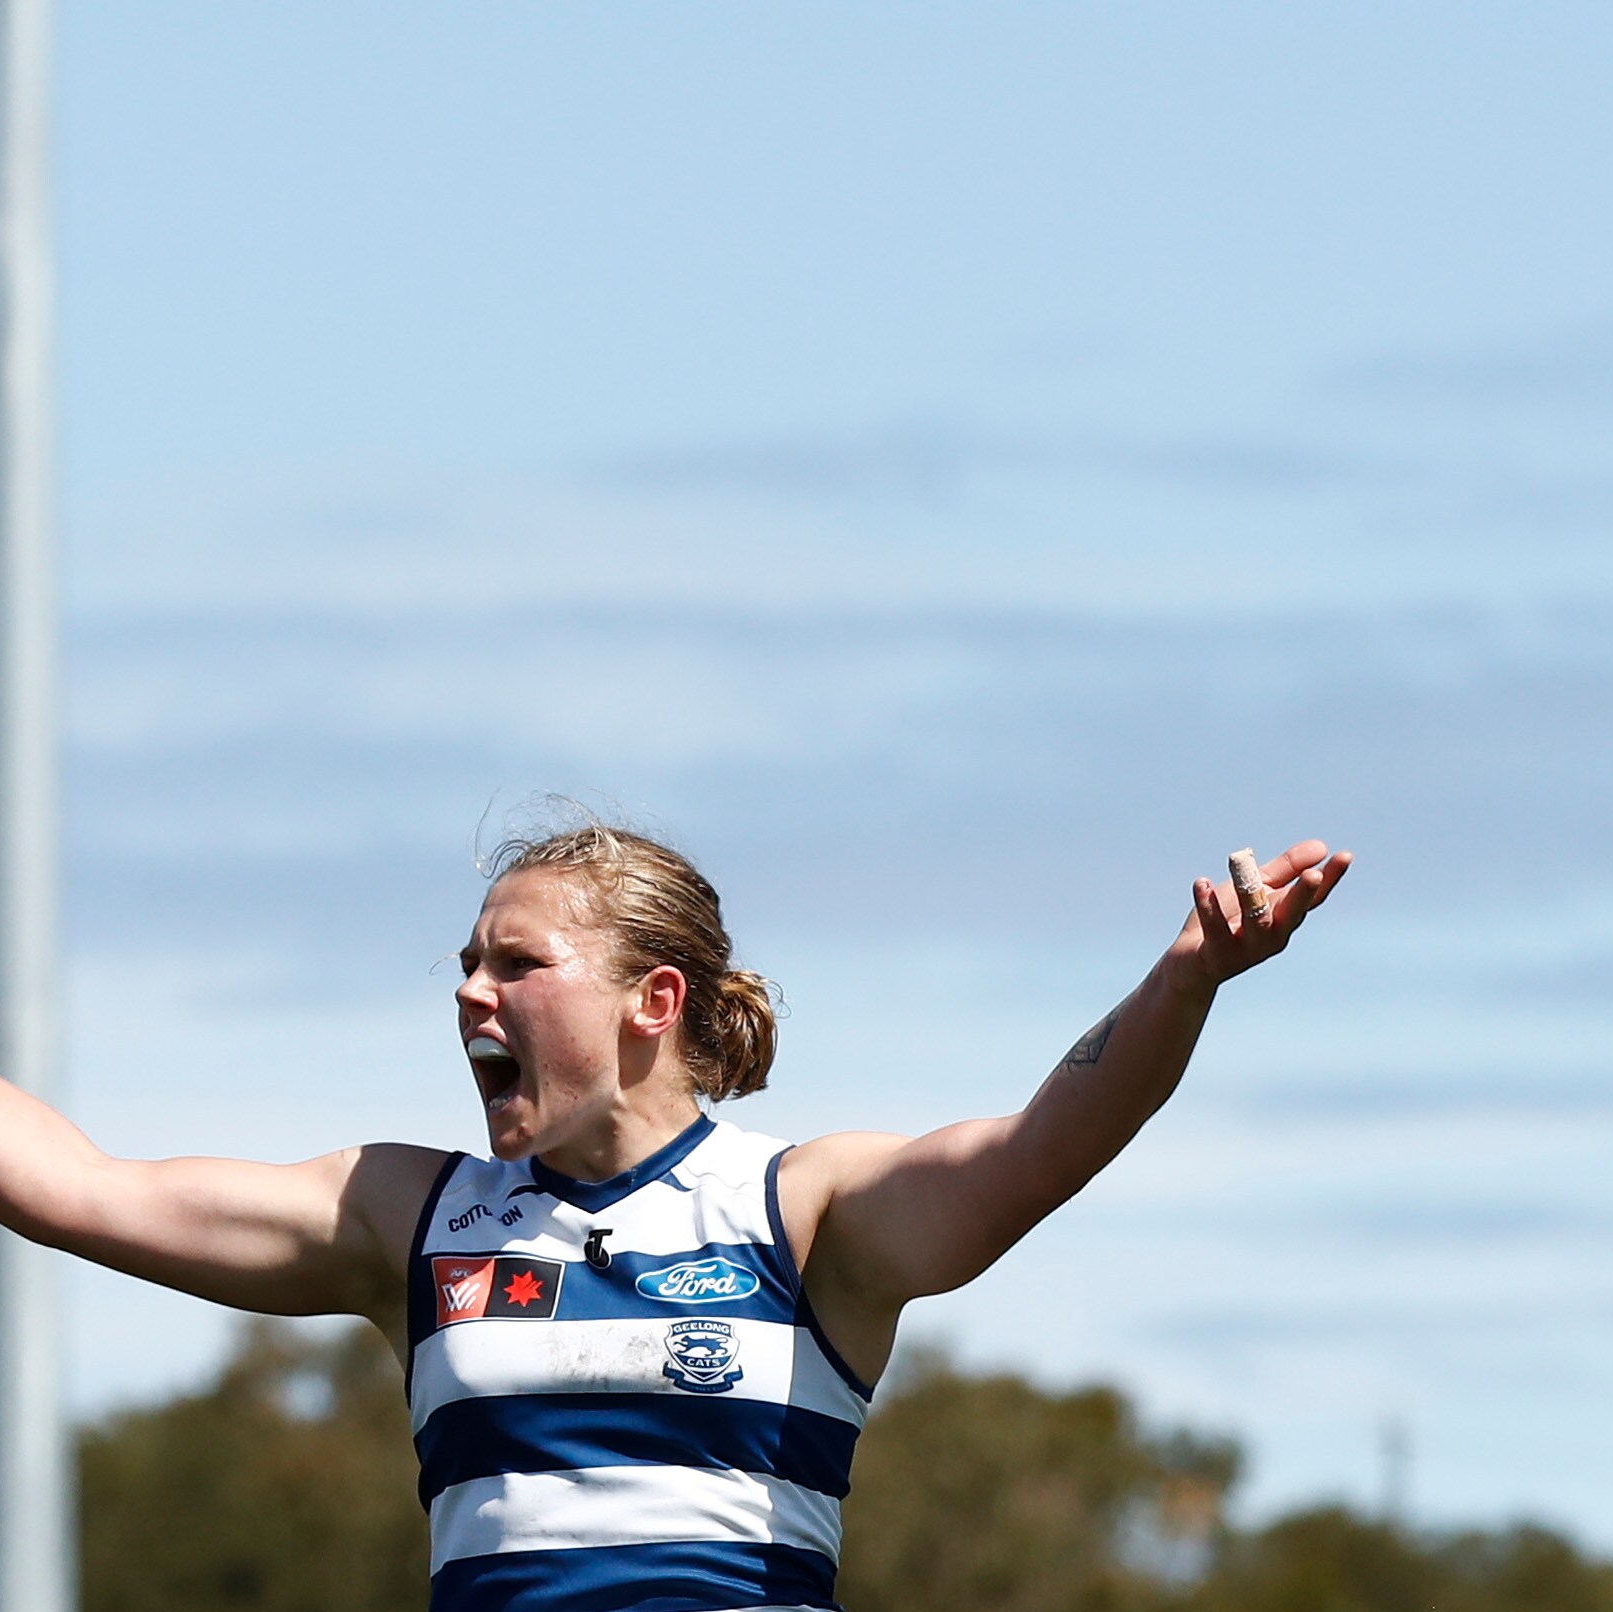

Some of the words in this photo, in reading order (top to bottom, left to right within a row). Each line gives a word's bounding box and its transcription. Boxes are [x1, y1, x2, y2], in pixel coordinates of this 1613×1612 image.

[658, 1264, 736, 1296] Ford
[673, 1322, 730, 1334] GEELONG
[687, 1358, 721, 1367] CATS
